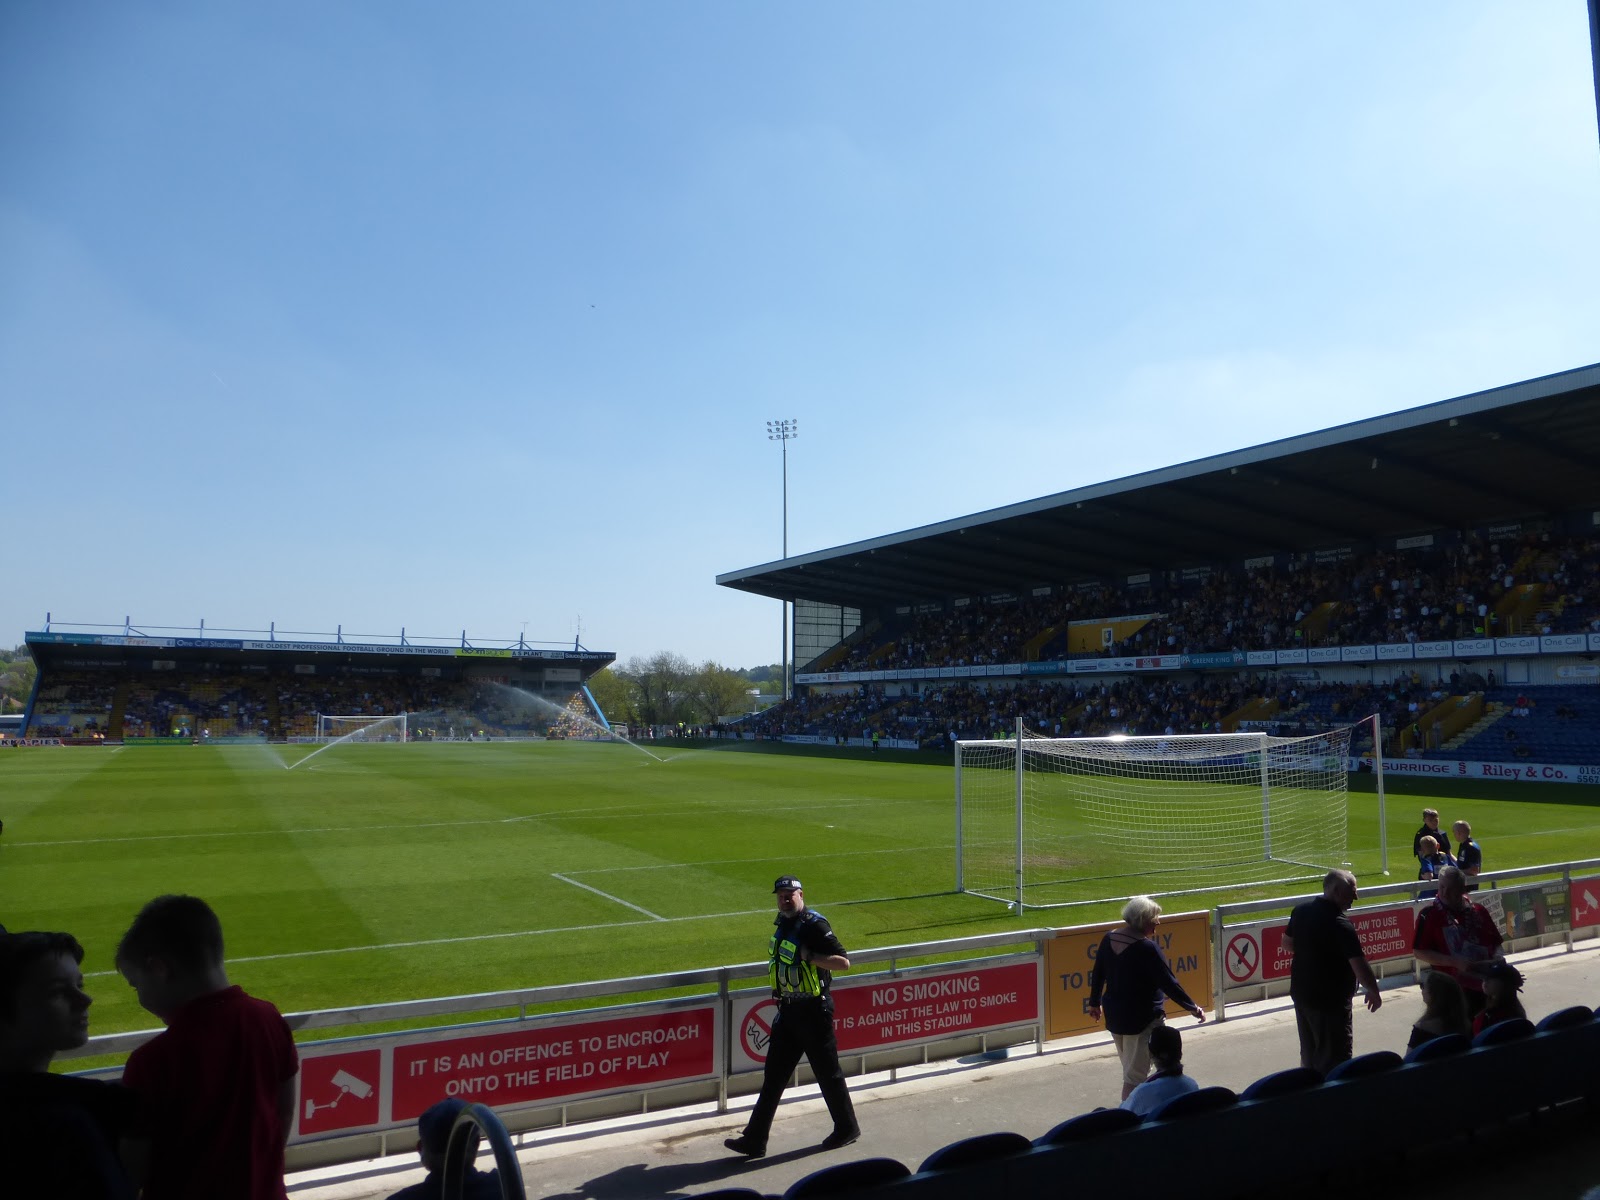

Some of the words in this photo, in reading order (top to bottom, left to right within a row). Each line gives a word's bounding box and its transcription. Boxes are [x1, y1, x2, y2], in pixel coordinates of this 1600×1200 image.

[194, 640, 209, 648] Call
[210, 640, 240, 649] Stadium
[293, 643, 341, 651] PROFESSIONAL
[1435, 643, 1449, 651] Call
[1457, 642, 1473, 650] One
[1476, 641, 1490, 649] Call
[1520, 639, 1535, 647] Call
[1565, 637, 1581, 645] Call
[1325, 649, 1337, 657] Call
[1380, 646, 1394, 654] One
[1181, 654, 1190, 664] IPA
[1192, 656, 1213, 665] GREENE
[1216, 656, 1230, 664] KING
[1233, 653, 1244, 662] IPA
[1382, 762, 1450, 774] SURRIDGE
[1482, 764, 1521, 780] Riley
[1525, 766, 1537, 778] &
[1542, 766, 1568, 780] Co.
[1353, 920, 1369, 932] LAW
[1371, 918, 1382, 929] TO
[1383, 916, 1398, 927] USE
[1156, 932, 1173, 950] LY
[1358, 934, 1367, 944] IS
[1369, 928, 1402, 942] STADIUM.
[1362, 940, 1406, 956] ROSECUTED
[1176, 955, 1198, 973] AN
[1060, 972, 1083, 990] TO
[872, 987, 898, 1007] NO
[902, 976, 980, 1003] SMOKING
[832, 1018, 841, 1030] T
[843, 1017, 854, 1029] IS
[857, 1008, 909, 1027] AGAINST
[911, 1004, 933, 1018] THE
[936, 1000, 960, 1015] LAW
[962, 998, 977, 1010] TO
[980, 991, 1017, 1008] SMOKE
[881, 1025, 893, 1038] IN
[896, 1021, 921, 1036] THIS
[924, 1013, 972, 1032] STADIUM
[410, 1059, 428, 1077] IT
[434, 1056, 452, 1073] IS
[457, 1051, 485, 1070] AN
[489, 1040, 573, 1066] OFFENCE
[578, 1037, 602, 1053] TO
[606, 1024, 699, 1050] ENCROACH
[445, 1075, 500, 1096] ONTO
[504, 1069, 540, 1088] THE
[545, 1062, 595, 1082] FIELD
[599, 1057, 622, 1074] OF
[627, 1051, 670, 1071] PLAY
